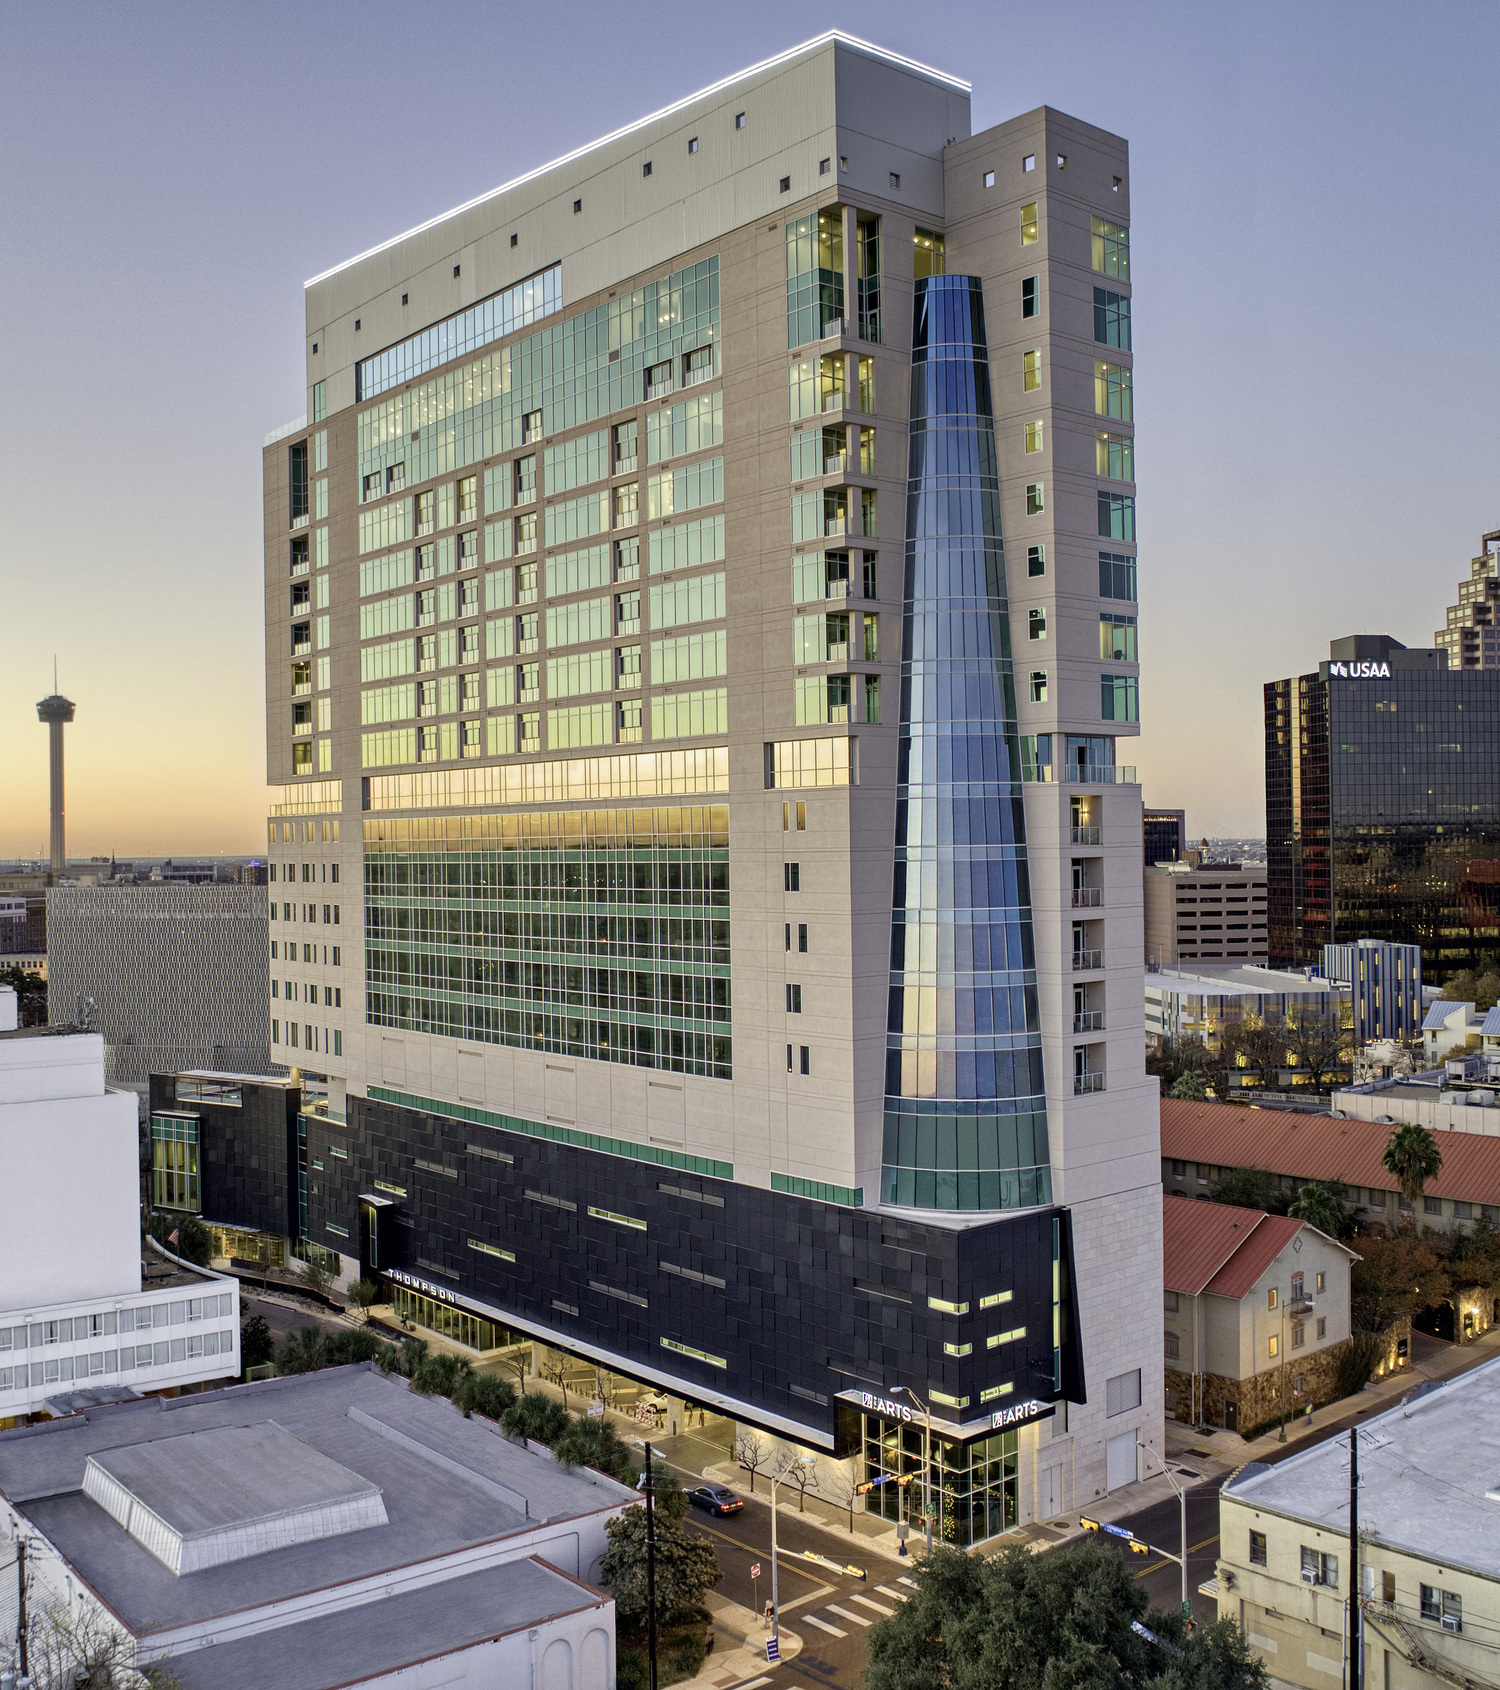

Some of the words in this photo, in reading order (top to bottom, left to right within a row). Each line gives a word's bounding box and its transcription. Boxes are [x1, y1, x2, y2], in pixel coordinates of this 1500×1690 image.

[1349, 662, 1391, 678] USAA
[388, 1268, 456, 1303] THOMPSON
[877, 1398, 912, 1422] ARTS
[1006, 1400, 1038, 1424] ARTS
